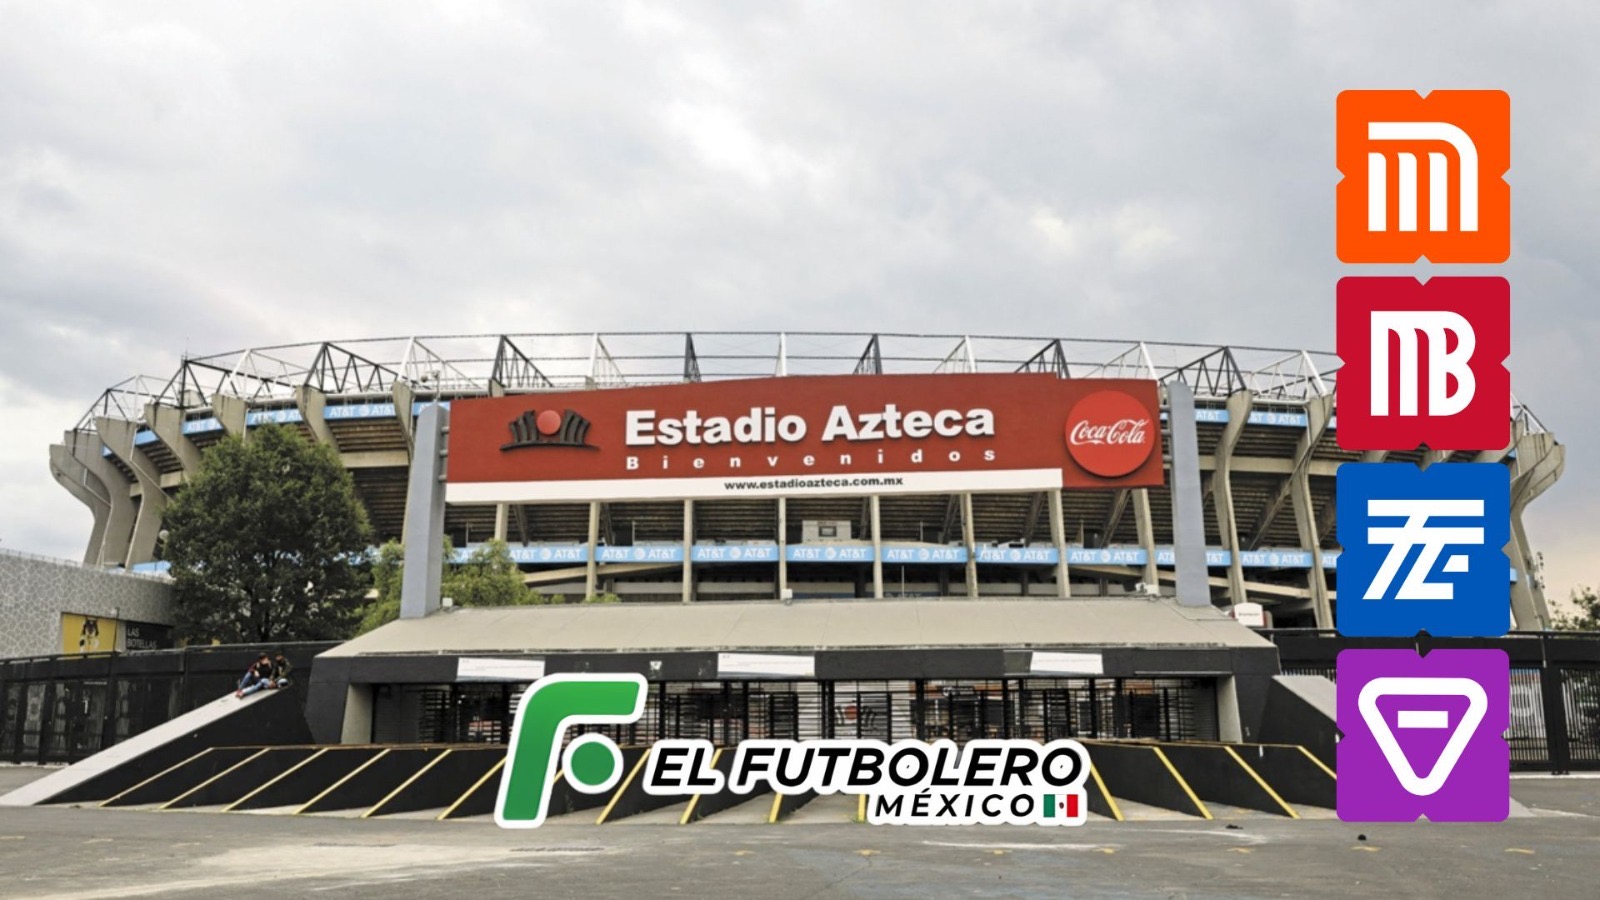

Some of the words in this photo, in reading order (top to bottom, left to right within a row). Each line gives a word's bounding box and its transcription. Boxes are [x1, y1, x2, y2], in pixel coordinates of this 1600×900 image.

[330, 406, 355, 418] AT&T
[1195, 410, 1221, 421] AT&T
[625, 407, 807, 446] Estadio
[821, 403, 995, 442] Azteca
[724, 476, 904, 490] www.estadioazteca.com.mx
[508, 550, 535, 560] AT&T
[554, 549, 581, 560] AT&T
[602, 549, 630, 559] AT&T
[647, 549, 677, 559] AT&T
[697, 548, 725, 558] AT&T
[744, 548, 771, 558] AT&T
[793, 548, 821, 559] AT&T
[838, 548, 867, 559] AT&T
[886, 549, 914, 559] AT&T
[932, 549, 960, 560] AT&T
[979, 550, 1007, 560] AT&T
[1023, 550, 1050, 561] AT&T
[1070, 551, 1097, 561] AT&T
[1113, 551, 1139, 562] AT&T
[1157, 551, 1175, 562] AT&
[1243, 554, 1266, 563] AT&T
[1281, 554, 1305, 564] AT&T
